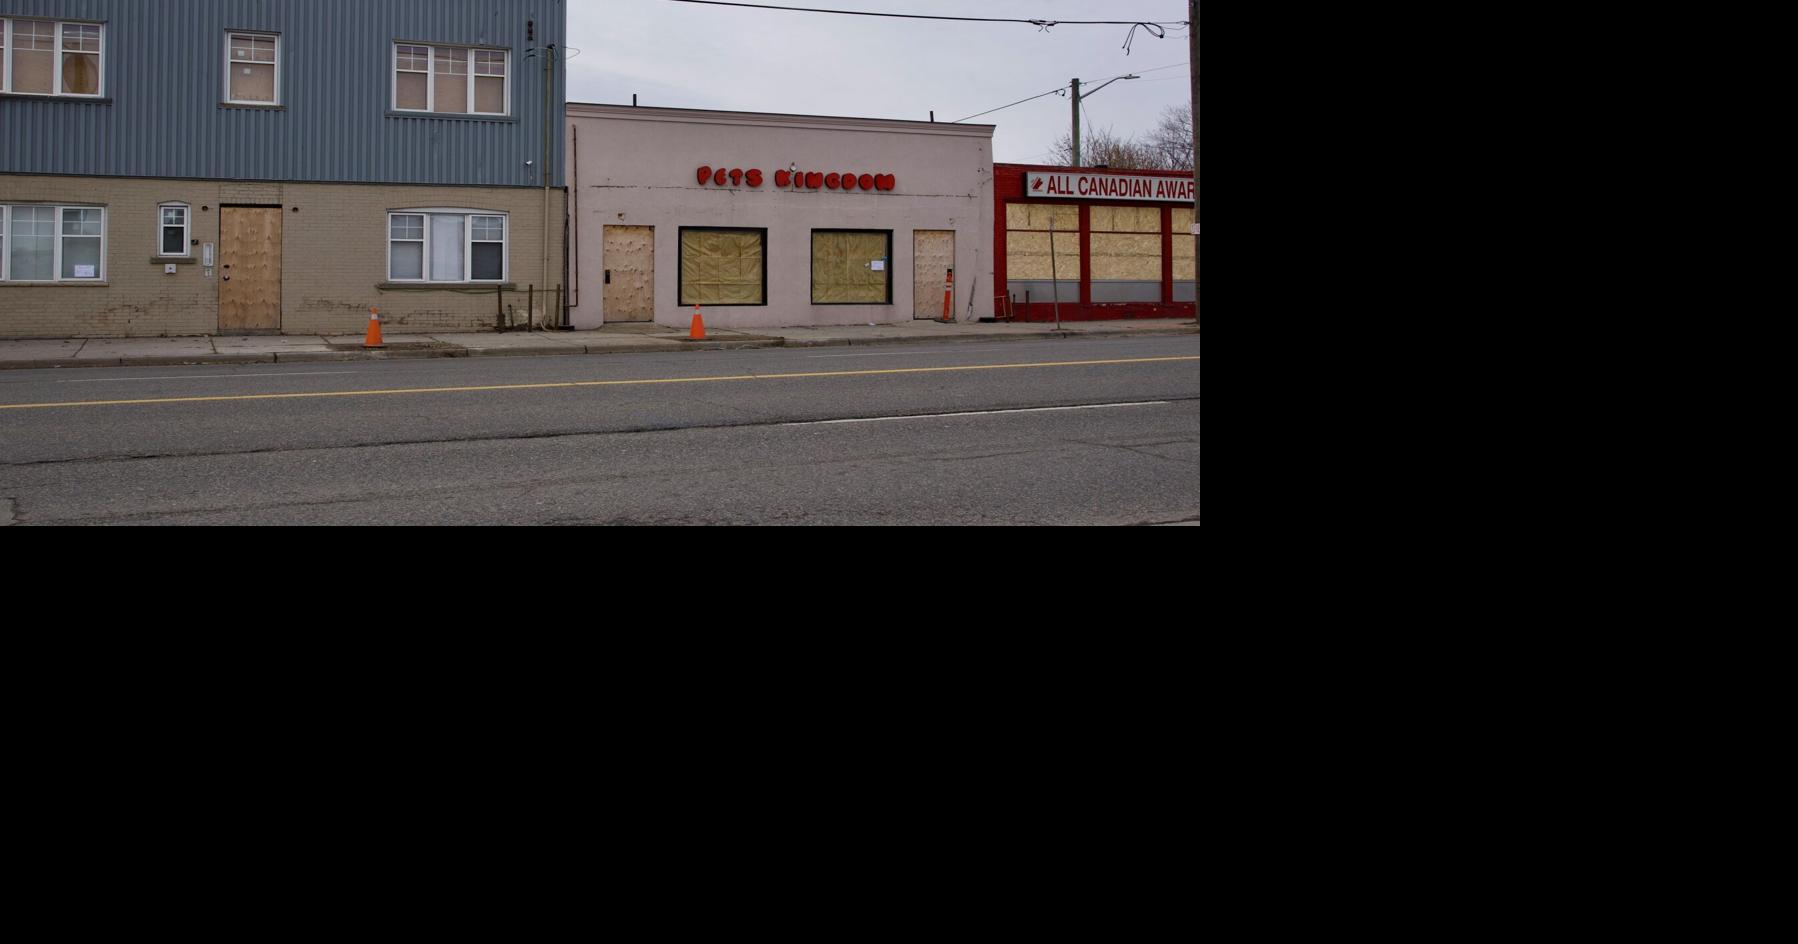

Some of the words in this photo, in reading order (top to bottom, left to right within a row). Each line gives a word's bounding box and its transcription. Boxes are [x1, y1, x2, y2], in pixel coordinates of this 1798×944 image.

[697, 165, 763, 187] PETS
[775, 169, 895, 191] KINGDOM
[1047, 175, 1074, 195] ALL
[1078, 176, 1152, 198] CANADIAN
